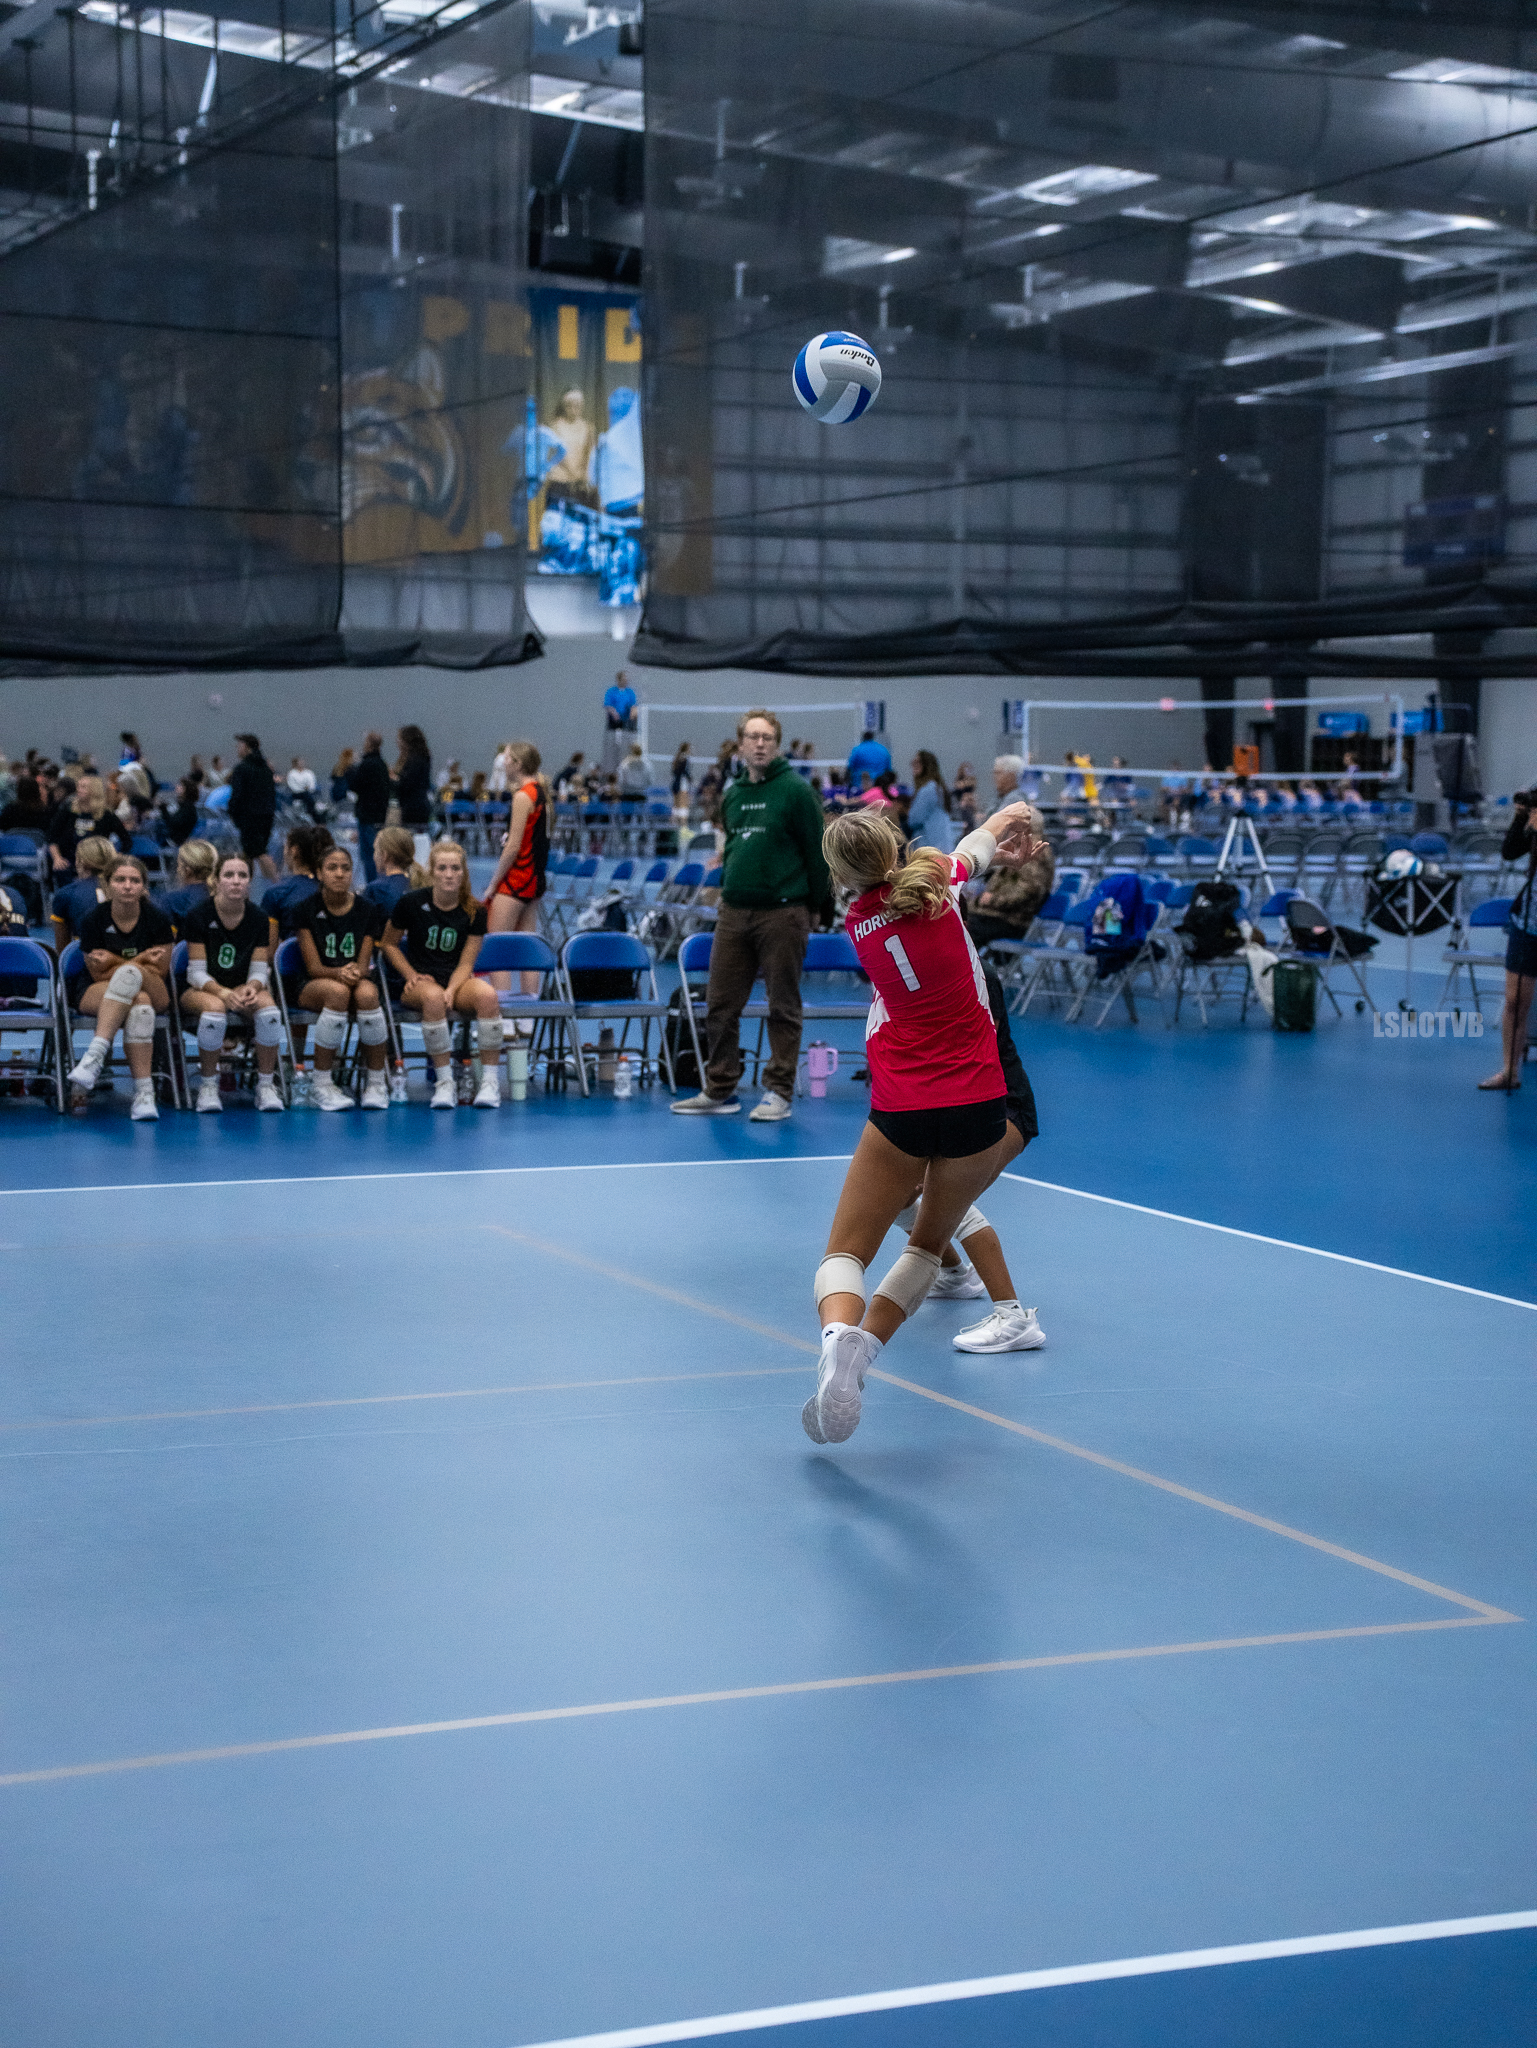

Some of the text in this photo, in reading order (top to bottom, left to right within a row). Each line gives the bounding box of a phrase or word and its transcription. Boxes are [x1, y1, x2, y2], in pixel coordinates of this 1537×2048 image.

[840, 349, 875, 367] Baden
[325, 932, 355, 958] 14
[425, 925, 457, 952] 10
[218, 943, 236, 969] 8
[884, 934, 921, 992] 1
